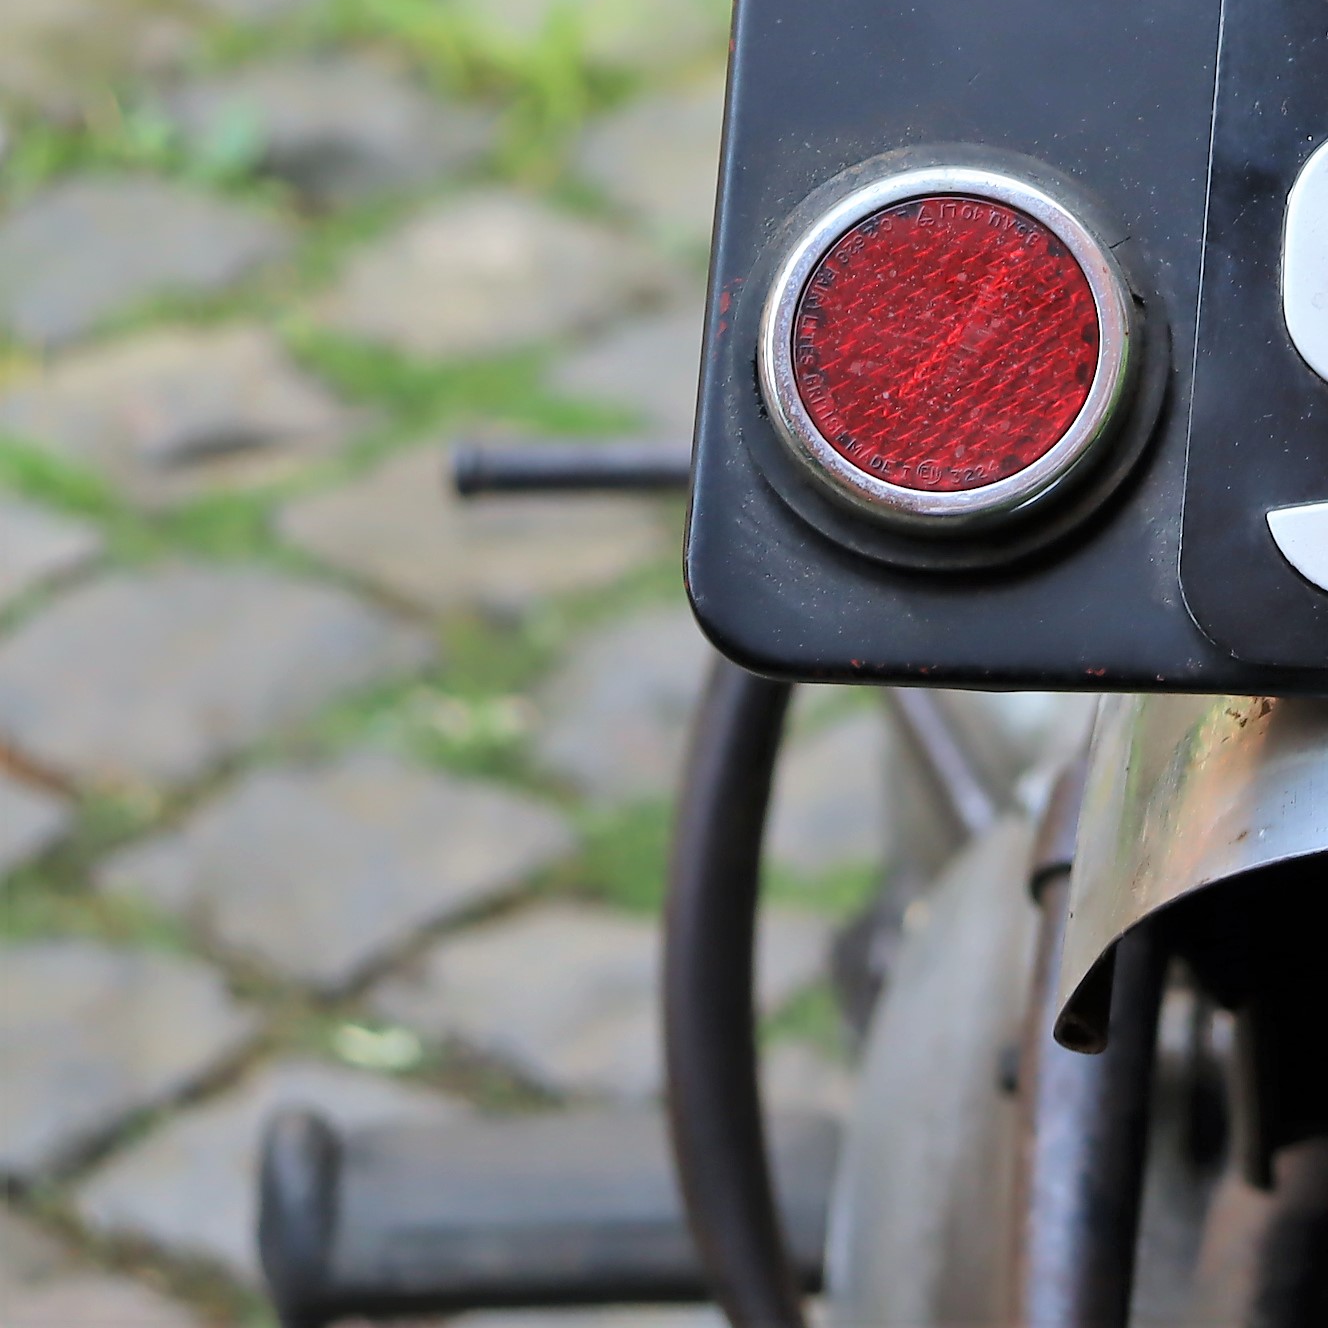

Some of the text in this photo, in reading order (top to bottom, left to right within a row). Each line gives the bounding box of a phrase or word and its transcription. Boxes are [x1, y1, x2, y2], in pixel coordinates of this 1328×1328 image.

[961, 205, 984, 221] 40
[804, 373, 849, 442] BRITISH
[845, 437, 897, 474] MADE
[950, 459, 999, 484] 3224
